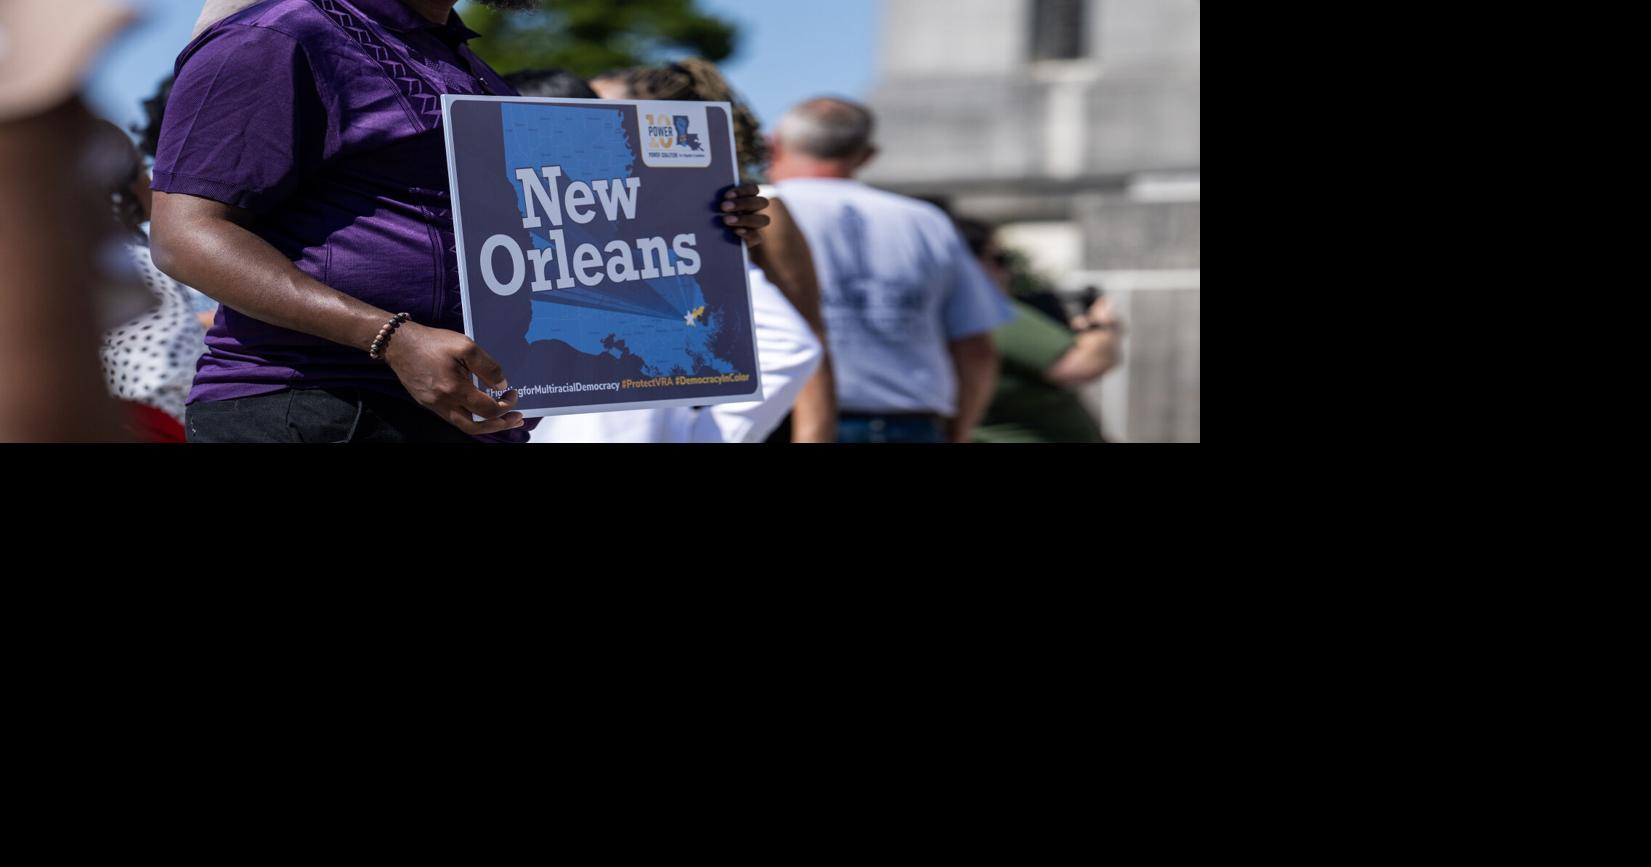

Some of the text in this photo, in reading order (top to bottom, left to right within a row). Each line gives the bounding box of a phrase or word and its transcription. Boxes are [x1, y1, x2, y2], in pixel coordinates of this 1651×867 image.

[648, 126, 673, 137] POWER
[515, 165, 641, 229] New
[479, 229, 702, 297] Orleans
[622, 376, 673, 388] #ProtectVRA
